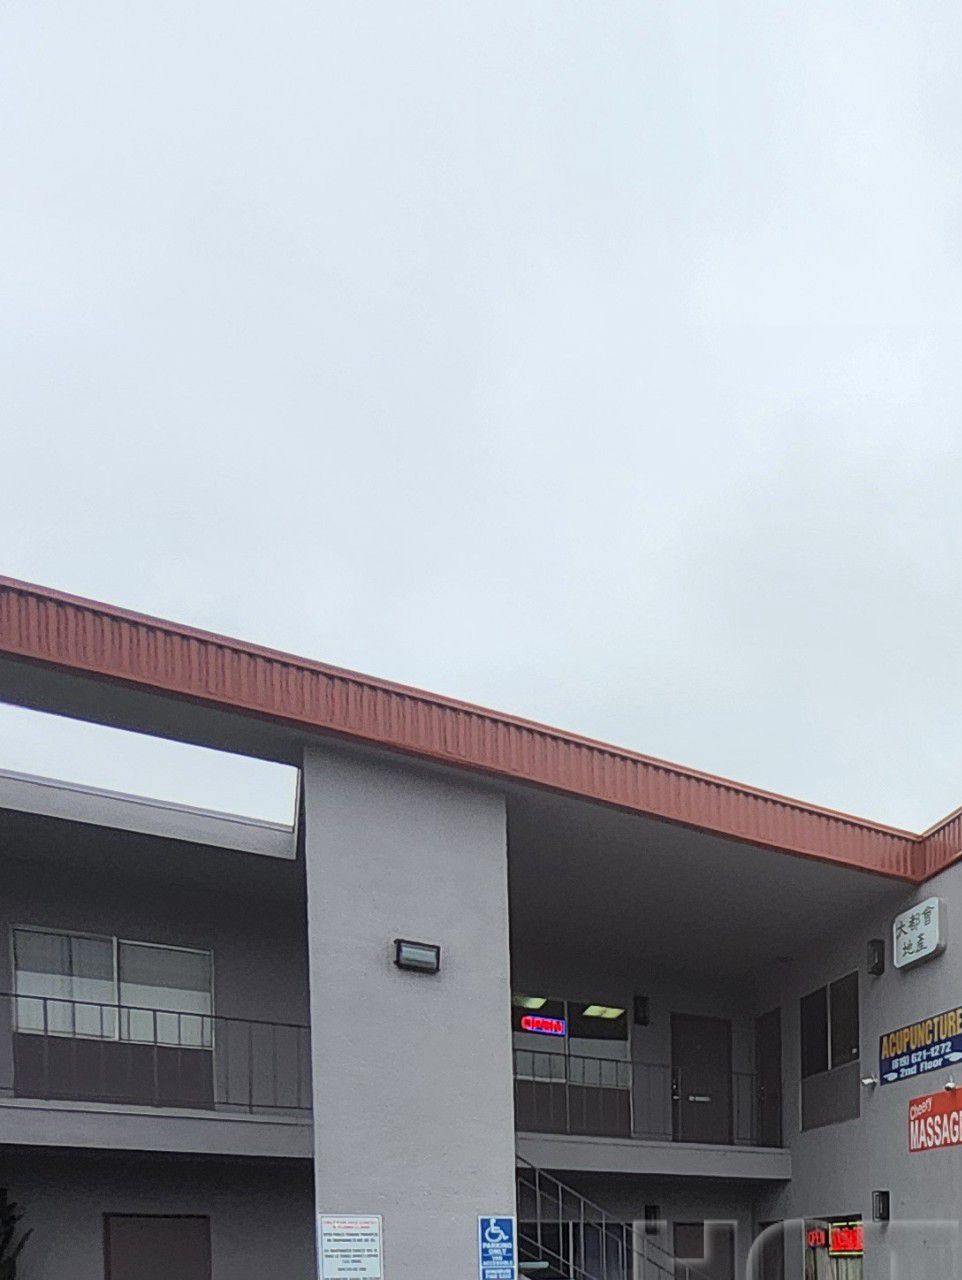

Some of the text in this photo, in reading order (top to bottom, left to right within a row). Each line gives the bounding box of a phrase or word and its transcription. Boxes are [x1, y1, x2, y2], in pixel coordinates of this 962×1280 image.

[881, 1008, 962, 1060] ACUPUNCTURE
[900, 1057, 944, 1078] 2nd Floor
